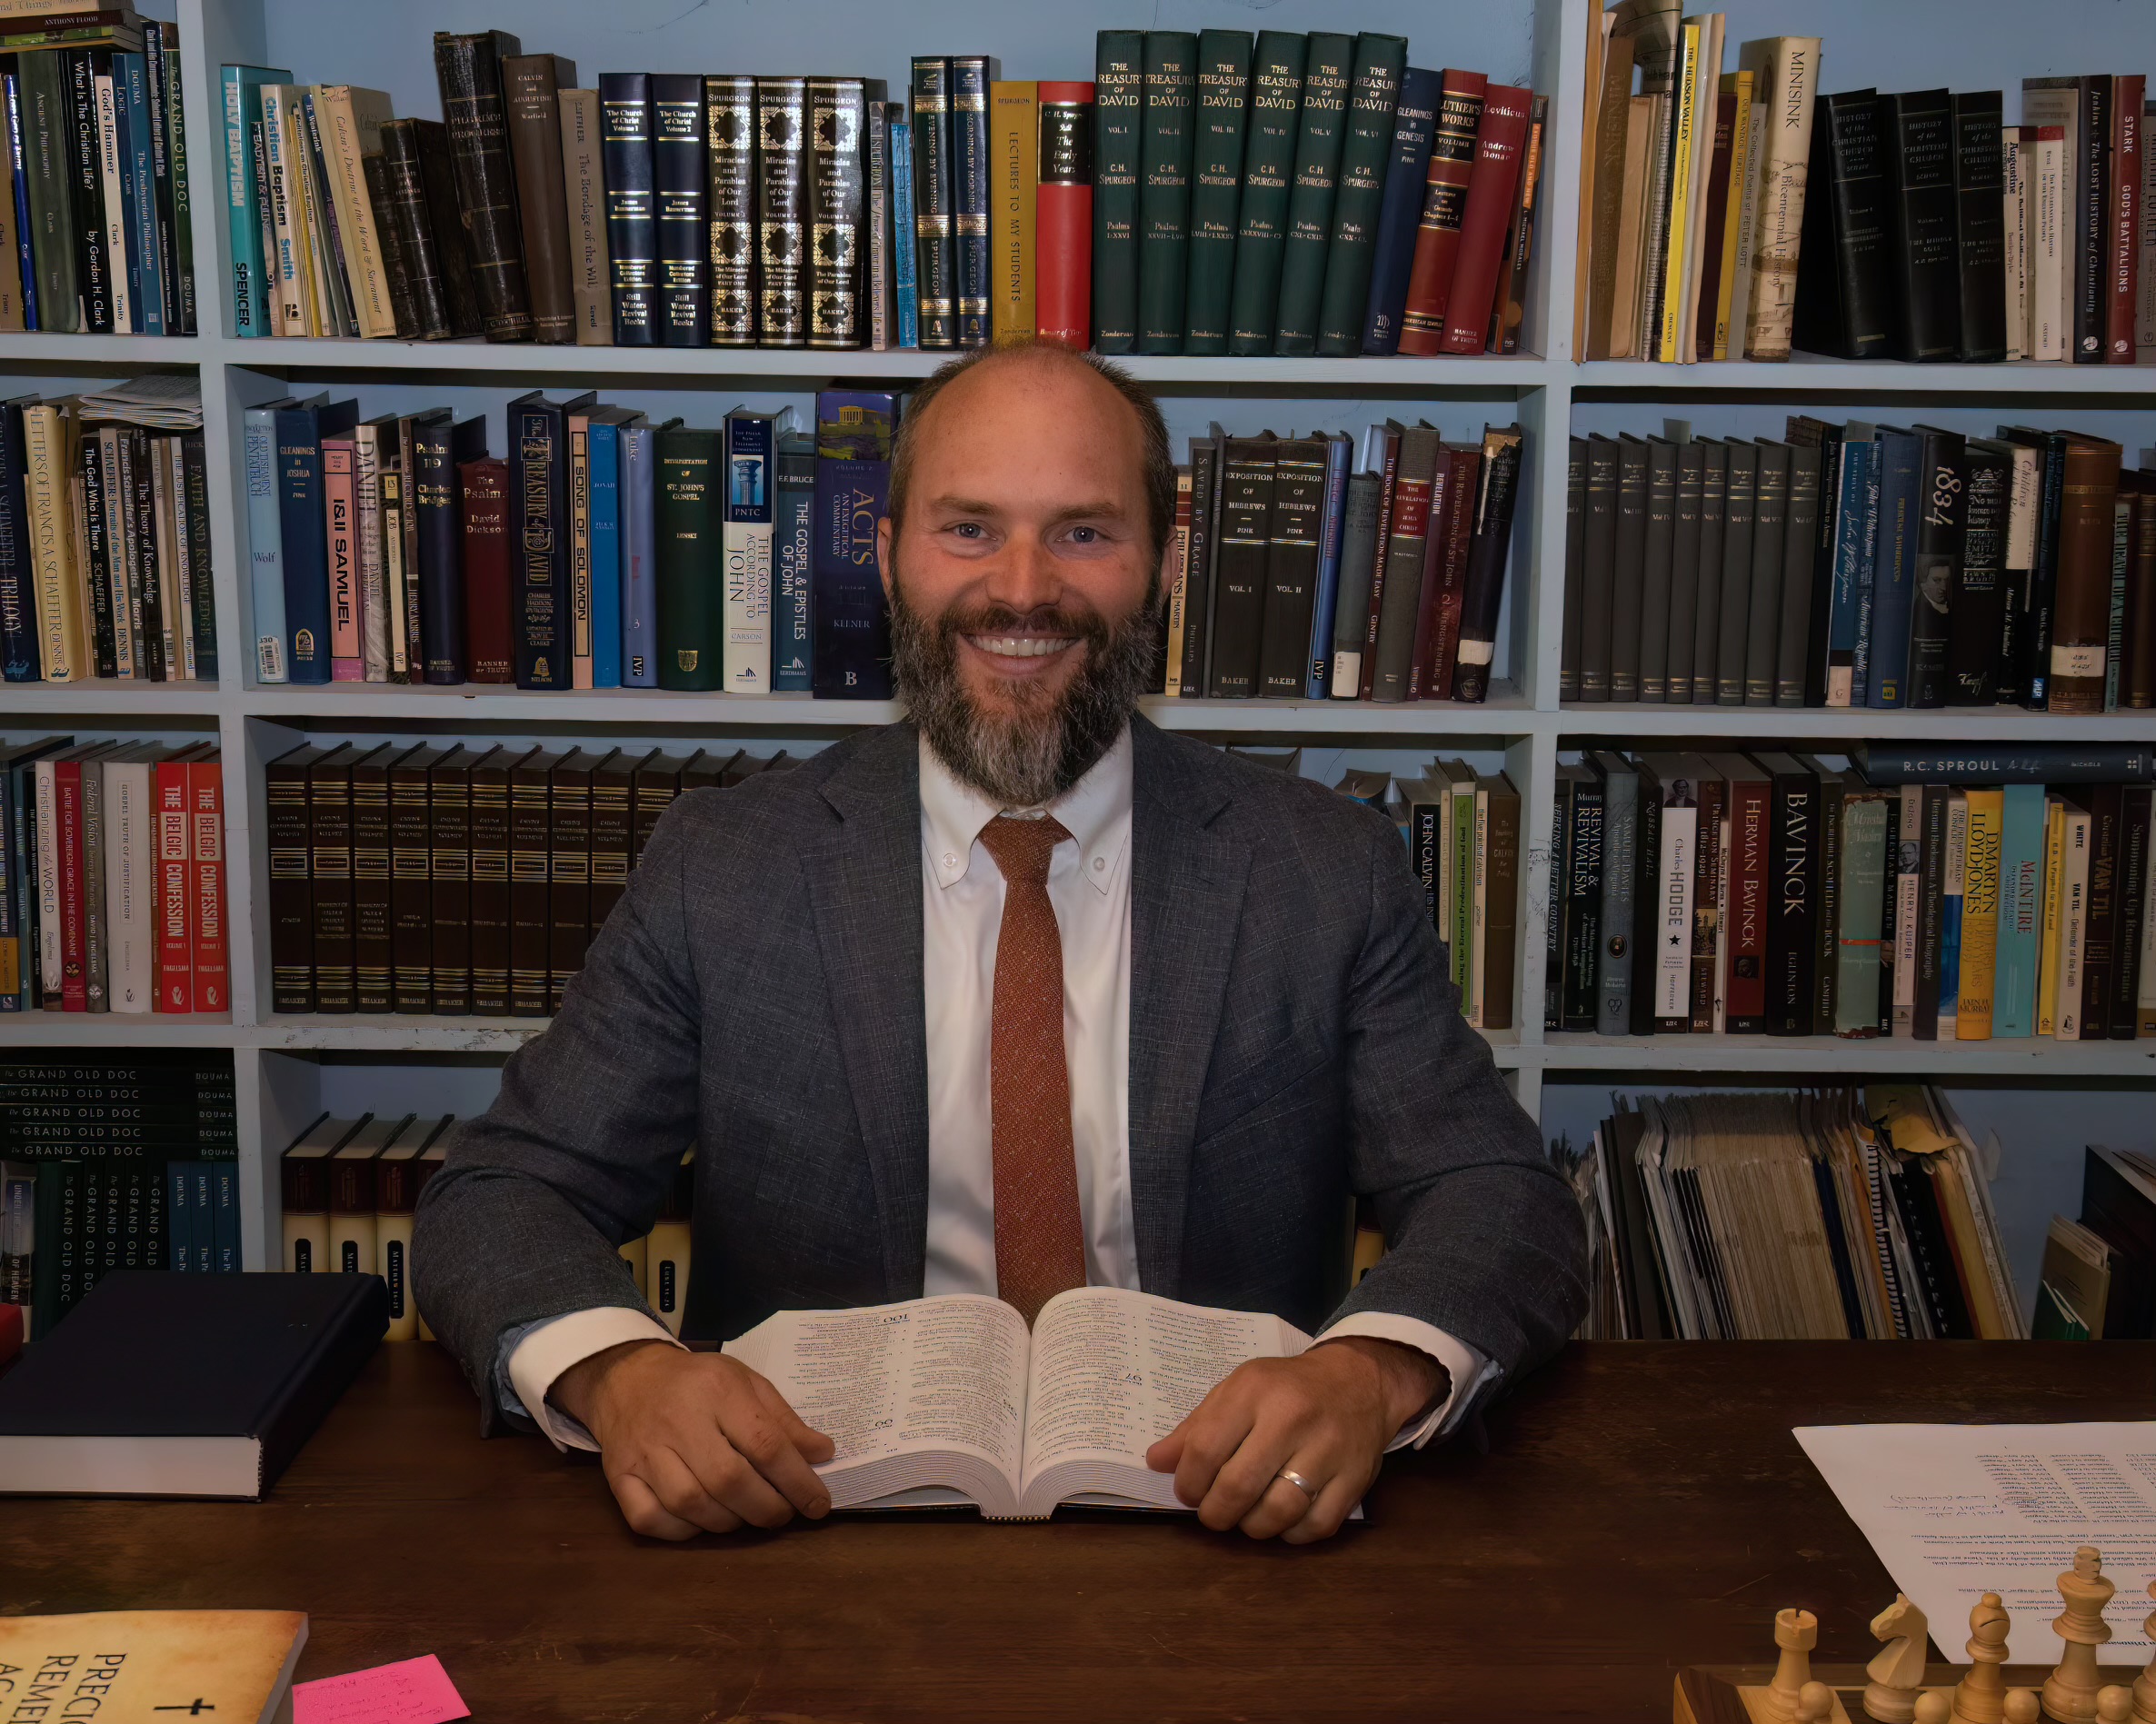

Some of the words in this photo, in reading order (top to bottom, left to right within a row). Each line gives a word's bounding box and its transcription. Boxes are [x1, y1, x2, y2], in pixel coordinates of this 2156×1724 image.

[45, 17, 75, 25] ANTHONY
[75, 62, 84, 84] What
[1110, 63, 1128, 71] THE
[76, 87, 85, 96] Is
[132, 70, 140, 105] DOUMA
[1682, 65, 1693, 103] HUDSON
[1785, 51, 1805, 128] MINISINK
[78, 99, 86, 116] The
[102, 88, 110, 120] God's
[172, 81, 183, 135] GRAND
[225, 82, 241, 125] HOLY
[1098, 95, 1139, 105] DAVID
[1397, 106, 1433, 120] GLEANINGS
[265, 96, 279, 162] Christian
[928, 115, 936, 156] EVENING
[1410, 120, 1417, 129] in
[1442, 114, 1474, 127] WORKS
[1680, 105, 1691, 142] VALLEY
[2123, 116, 2134, 153] STARK
[79, 118, 89, 165] Christian
[105, 125, 114, 174] Hammer
[1396, 131, 1424, 143] GENESIS
[175, 141, 186, 171] OLD
[227, 128, 245, 206] BAPTISM
[929, 160, 936, 170] BY
[1009, 133, 1019, 193] LECTURES
[2009, 142, 2018, 194] Augustine
[83, 169, 94, 190] Life?
[139, 168, 148, 219] Presbyterian
[714, 177, 745, 185] Parables
[1099, 174, 1136, 184] SPURGEON
[176, 180, 188, 211] DOC
[273, 165, 286, 225] Baptism
[722, 198, 738, 206] Lord
[1010, 198, 1019, 212] TO
[1776, 174, 1792, 244] Bicentennial
[2121, 184, 2131, 223] GOD'S
[88, 231, 95, 244] by
[1011, 219, 1019, 236] MY
[143, 222, 153, 270] Philosopher
[279, 238, 293, 280] Smith
[2118, 225, 2131, 293] BATTALIONS
[90, 247, 99, 280] Gordon
[932, 240, 940, 295] SPURGEON
[1011, 242, 1021, 302] STUDENTS
[1773, 248, 1786, 288] History
[93, 284, 99, 298] H.
[184, 276, 193, 314] DOUMA
[236, 263, 249, 326] SPENCER
[93, 301, 102, 325] Clark
[116, 294, 125, 321] Trinity
[85, 448, 95, 466] The
[629, 436, 637, 461] Luke
[85, 469, 95, 485] God
[138, 483, 147, 499] The
[575, 467, 585, 508] SONG
[1196, 458, 1208, 505] SAVED
[1385, 476, 1394, 497] BOOK
[87, 487, 96, 510] Who
[1228, 503, 1266, 511] HEBREWS
[1279, 503, 1316, 512] HEBREWS
[1384, 499, 1392, 510] OF
[1925, 466, 1962, 525] 1834
[89, 512, 97, 520] Is
[140, 502, 151, 535] Theory
[333, 499, 346, 531] I&II
[388, 514, 396, 529] JOB
[472, 514, 500, 524] David
[735, 508, 760, 516] PNTC
[796, 502, 808, 525] THE
[851, 489, 874, 565] ACTS
[1195, 509, 1203, 523] BY
[90, 523, 99, 551] There
[576, 518, 585, 539] OF
[1380, 512, 1392, 557] REVELATION
[143, 539, 151, 550] of
[255, 552, 275, 563] Wolf
[760, 536, 769, 556] THE
[783, 545, 794, 559] OF
[795, 529, 808, 574] GOSPEL
[1192, 533, 1203, 576] GRACE
[144, 552, 154, 604] Knowledge
[727, 549, 744, 603] JOHN
[746, 533, 755, 602] ACCORDING
[782, 562, 793, 595] JOHN
[796, 578, 807, 586] &
[1377, 559, 1386, 579] MADE
[94, 563, 105, 613] SCHAEFFER
[334, 539, 350, 631] SAMUEL
[576, 547, 585, 621] SOLOMON
[757, 560, 769, 617] GOSPEL
[1373, 581, 1382, 598] EASY
[133, 598, 141, 630] Morris
[746, 605, 754, 619] TO
[794, 591, 807, 640] EPISTLES
[1369, 615, 1378, 643] GENTRY
[633, 657, 643, 676] IVP
[1268, 677, 1297, 685] BAKER
[1314, 660, 1324, 680] IVP
[1903, 762, 1930, 771] R.C.
[1936, 761, 1999, 772] SPROUL
[165, 786, 182, 808] THE
[199, 787, 215, 810] THE
[1577, 793, 1603, 802] Murray
[165, 815, 182, 857] BELGIC
[199, 816, 215, 858] BELGIC
[1421, 813, 1433, 842] JOHN
[1588, 807, 1602, 871] REVIVAL
[1744, 800, 1762, 872] HERMAN
[1573, 807, 1591, 896] REVIVALISM
[1673, 838, 1682, 870] Charles
[1783, 792, 1809, 917] BAVINCK
[1587, 875, 1599, 887] &
[166, 864, 184, 938] CONFESSION
[200, 864, 218, 939] CONFESSION
[1668, 872, 1682, 926] HODGE
[2016, 861, 2036, 934] McINTIRE
[1742, 880, 1759, 948] BAVINCK
[18, 1070, 66, 1080] GRAND
[74, 1071, 100, 1080] OLD
[107, 1071, 136, 1080] DOC
[195, 1072, 230, 1081] DOUMA
[25, 1145, 73, 1155] GRAND
[80, 1147, 106, 1156] OLD
[114, 1147, 143, 1156] DOC
[883, 1313, 909, 1323] 100
[59, 1653, 127, 1724] PRECI
